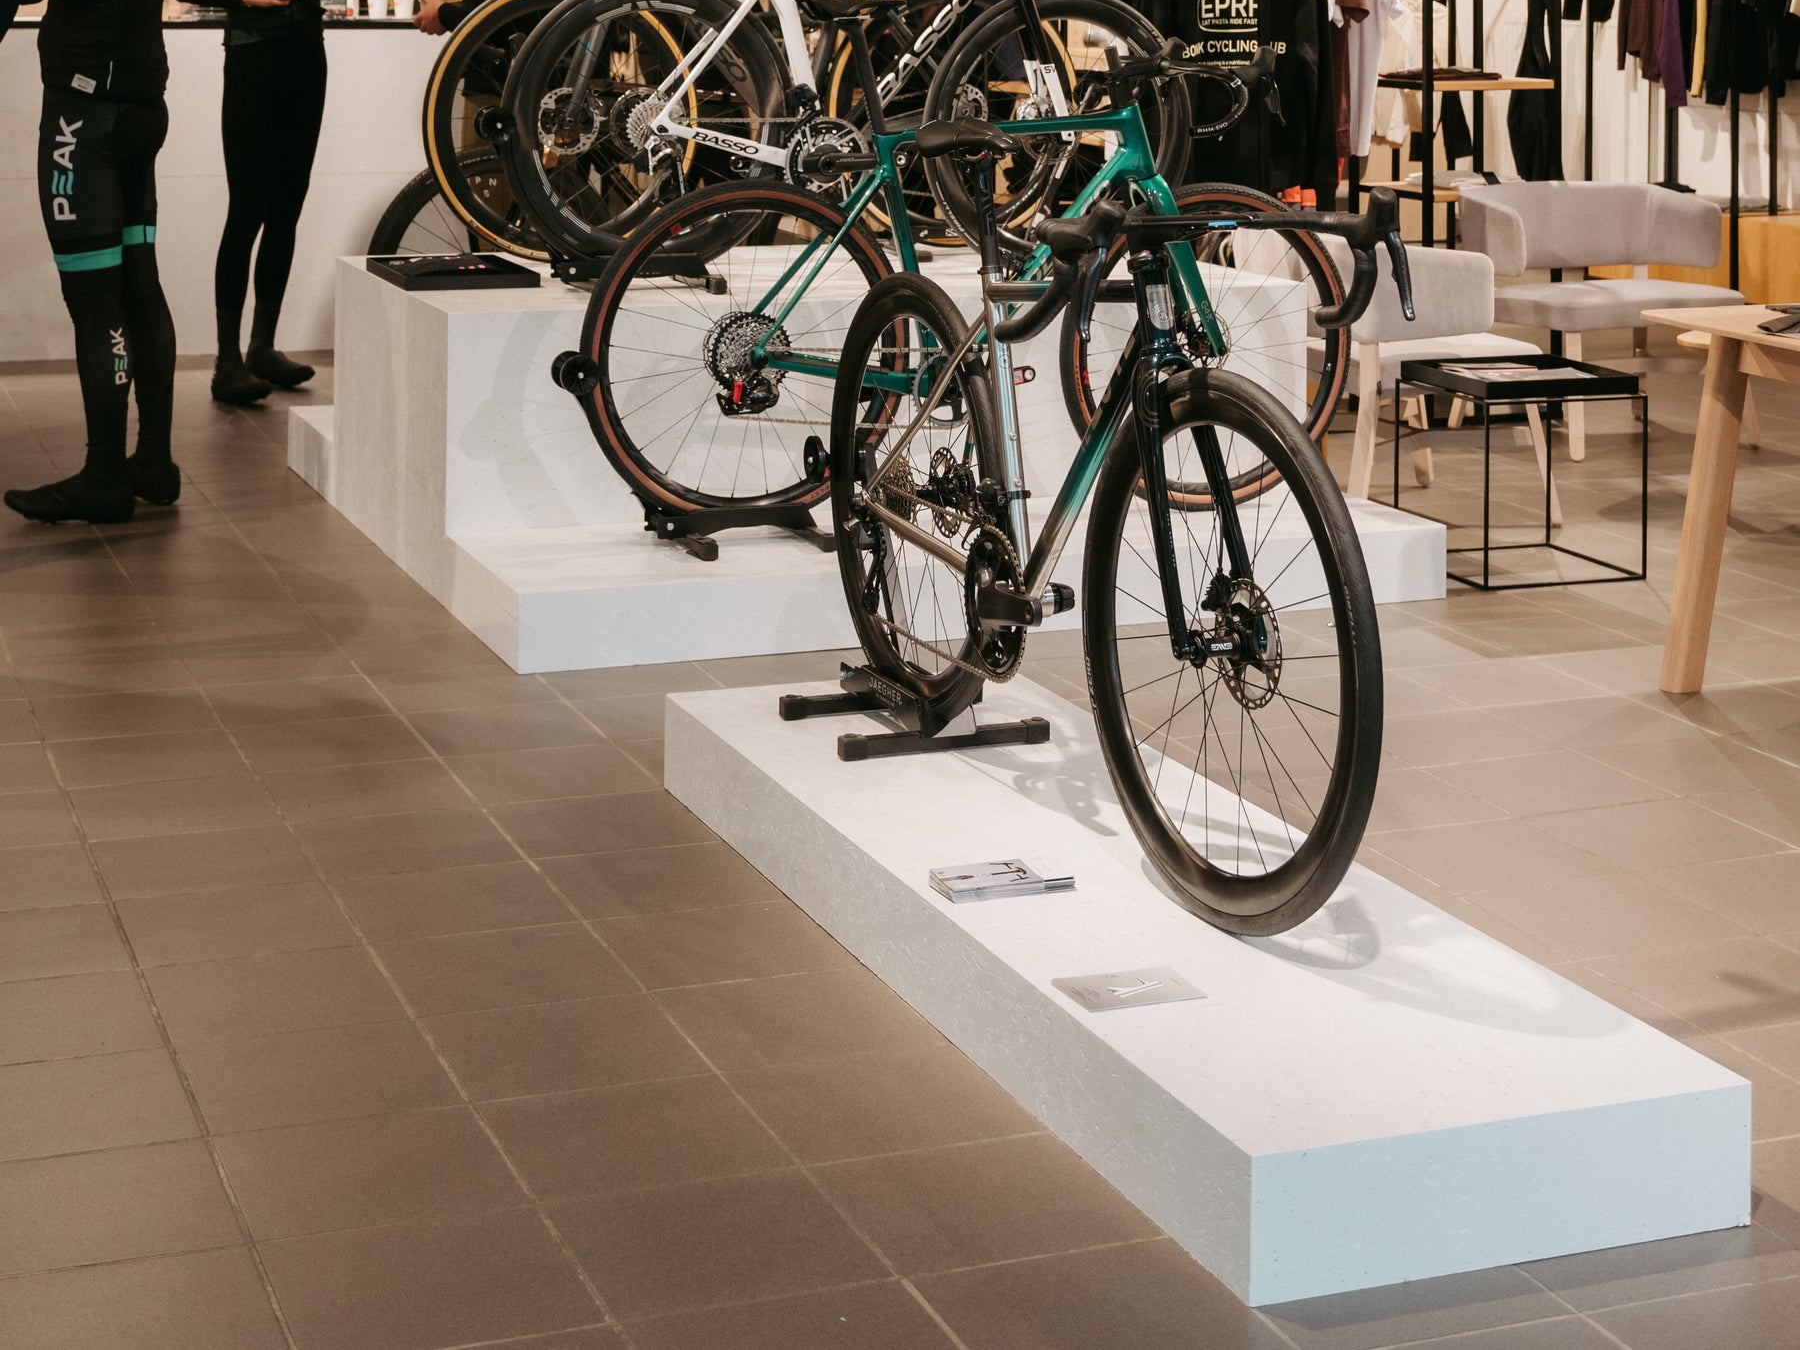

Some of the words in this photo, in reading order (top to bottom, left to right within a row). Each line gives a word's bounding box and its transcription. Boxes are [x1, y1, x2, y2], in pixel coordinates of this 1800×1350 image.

[1207, 39, 1259, 53] CYCLING
[692, 131, 759, 155] BASSO
[51, 115, 84, 221] PEAK
[489, 177, 498, 186] N
[109, 327, 128, 385] PEAK
[869, 676, 902, 705] JAEGHER
